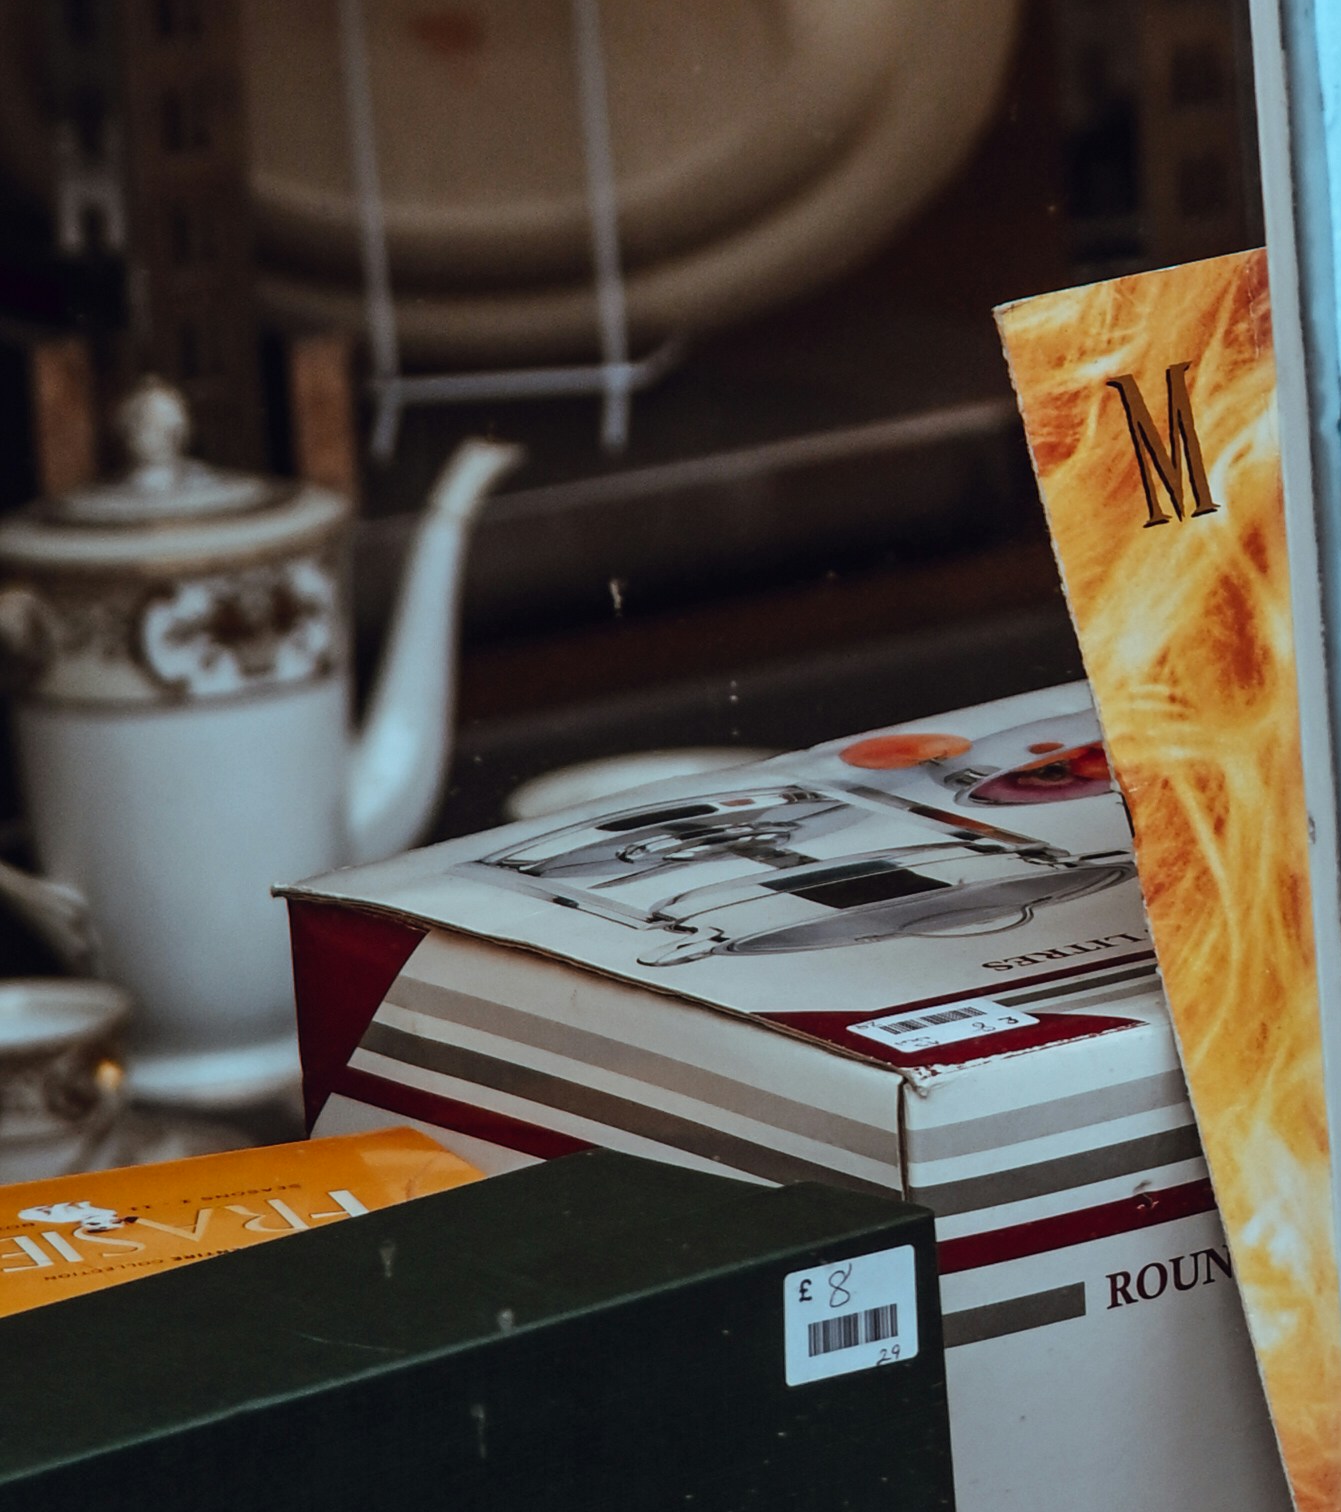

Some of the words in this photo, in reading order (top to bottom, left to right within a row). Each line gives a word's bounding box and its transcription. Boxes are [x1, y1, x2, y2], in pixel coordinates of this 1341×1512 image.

[982, 932, 1142, 972] LITRES
[200, 1182, 301, 1203] SEASONS
[43, 1258, 164, 1281] COLLECTION
[798, 1278, 813, 1303] £
[828, 1262, 853, 1308] 8
[876, 1343, 901, 1366] 29
